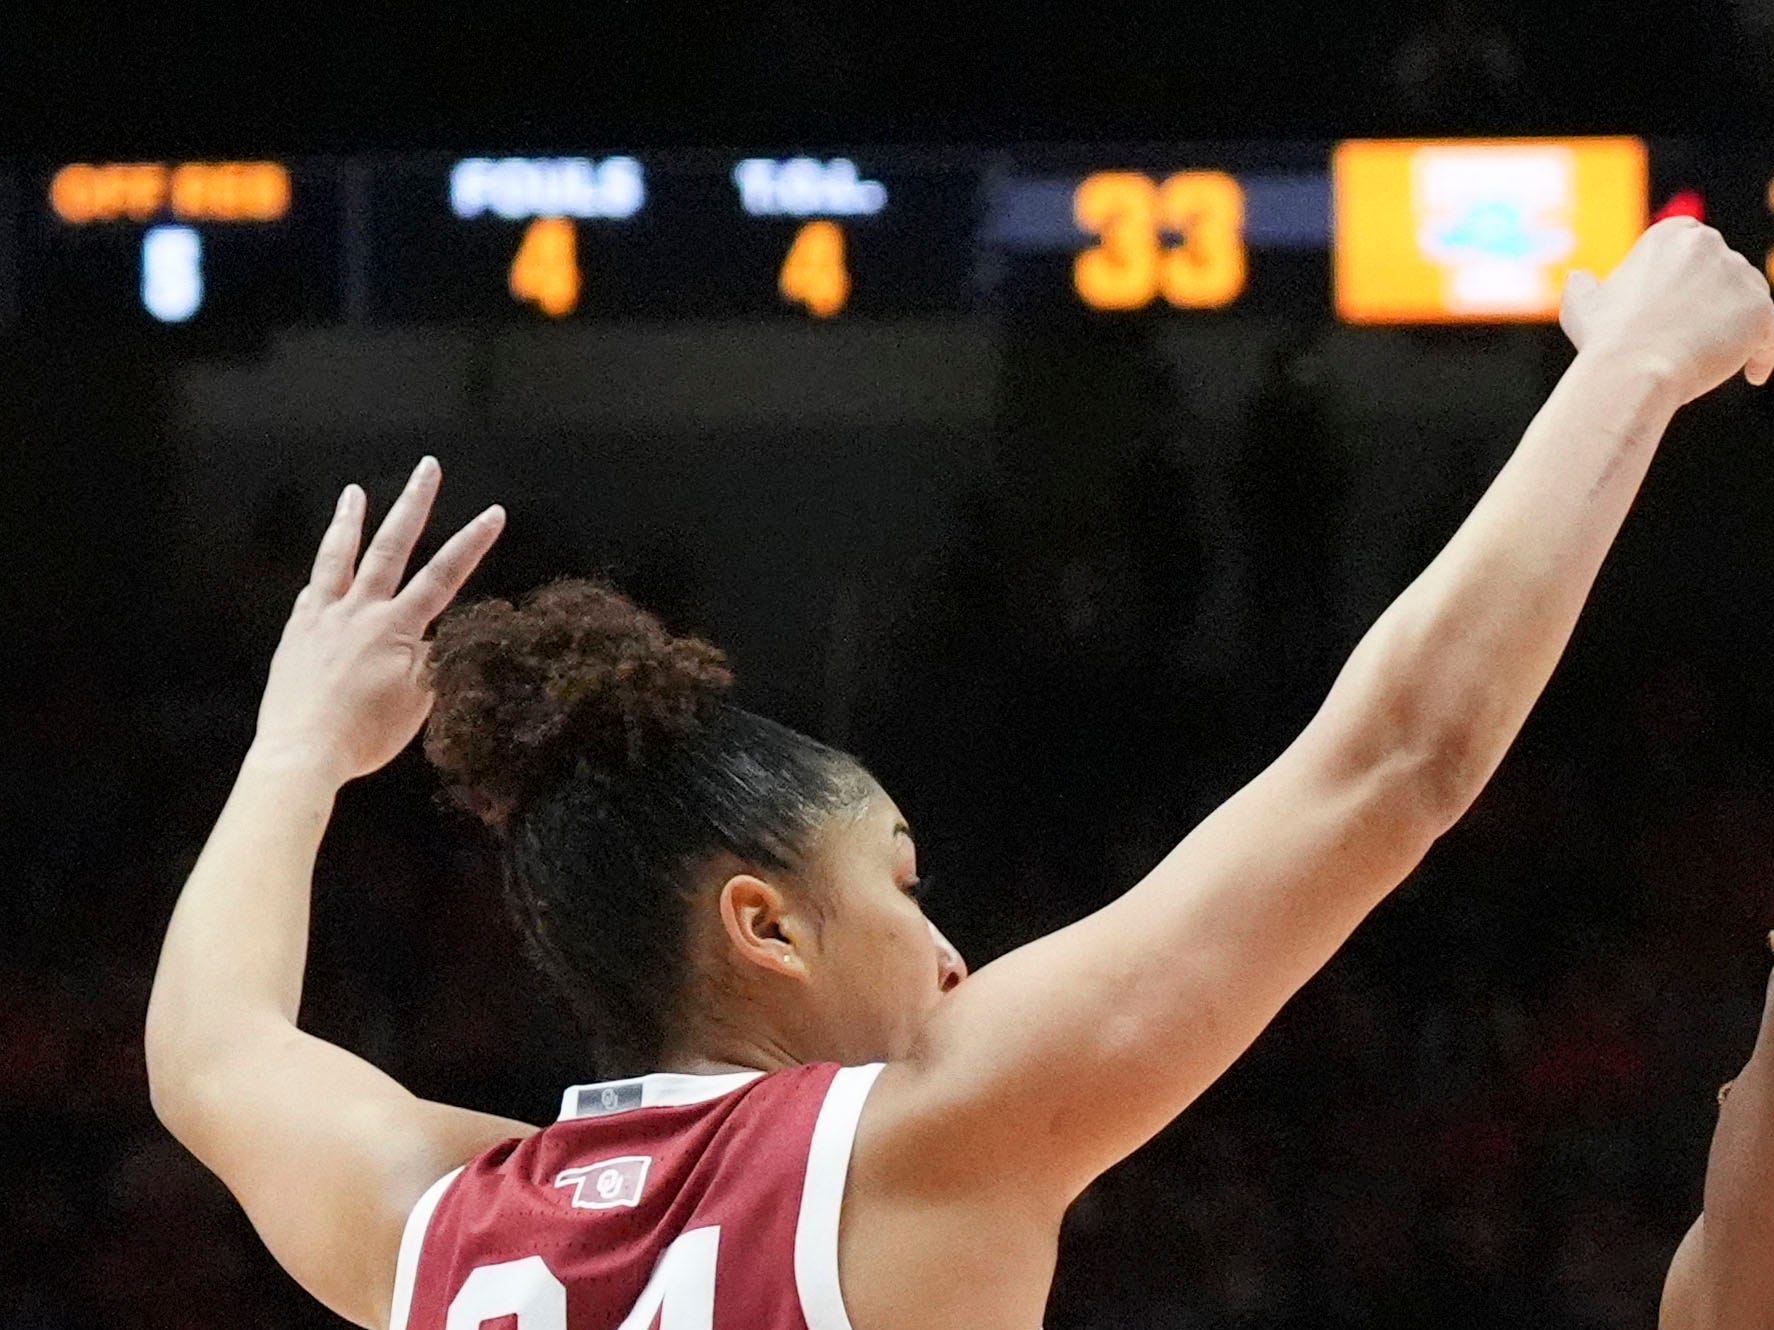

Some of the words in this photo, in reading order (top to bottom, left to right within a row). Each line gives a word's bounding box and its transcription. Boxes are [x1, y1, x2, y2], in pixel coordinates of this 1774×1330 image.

[510, 217, 582, 315] 4
[781, 221, 849, 316] 4
[1073, 171, 1246, 309] 33
